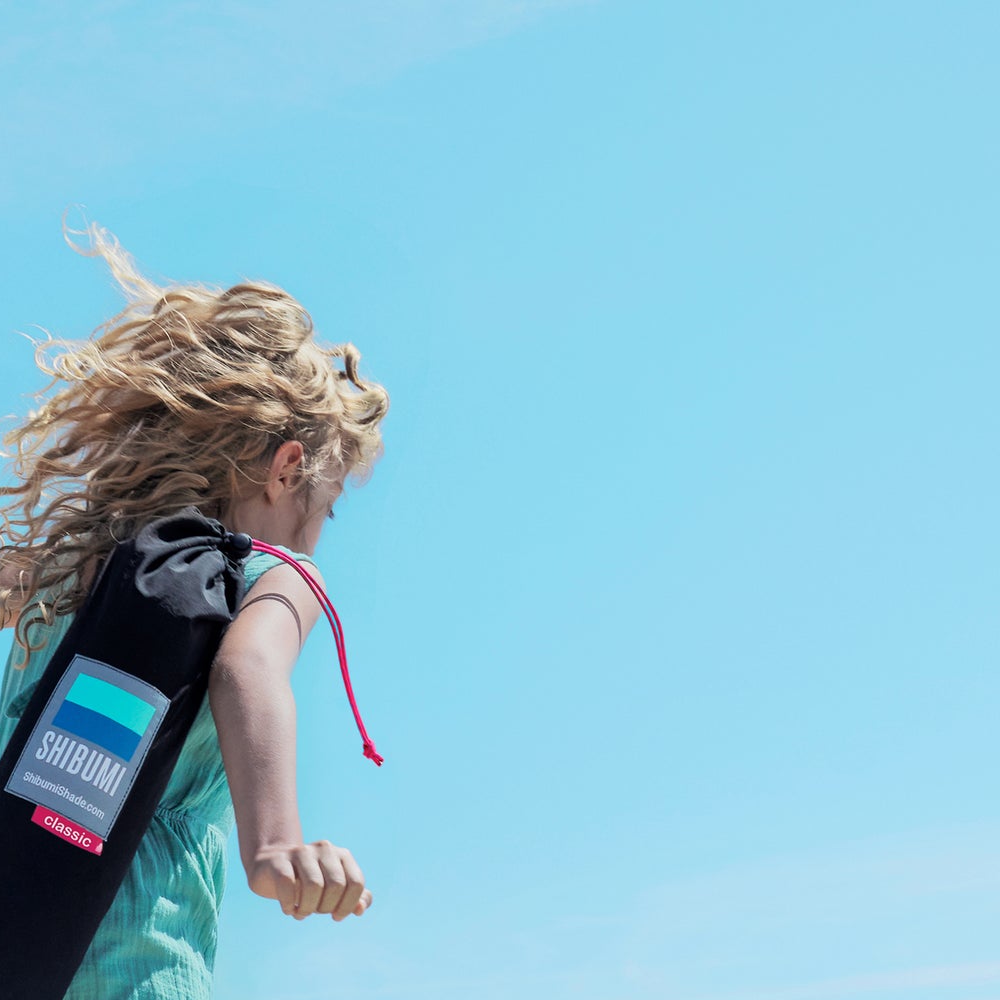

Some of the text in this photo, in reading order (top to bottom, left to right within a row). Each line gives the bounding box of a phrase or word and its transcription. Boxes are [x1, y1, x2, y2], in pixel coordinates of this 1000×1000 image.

[35, 731, 127, 796] SHIBUMI
[23, 772, 105, 820] ShibumiShade.com
[44, 815, 92, 848] classic
